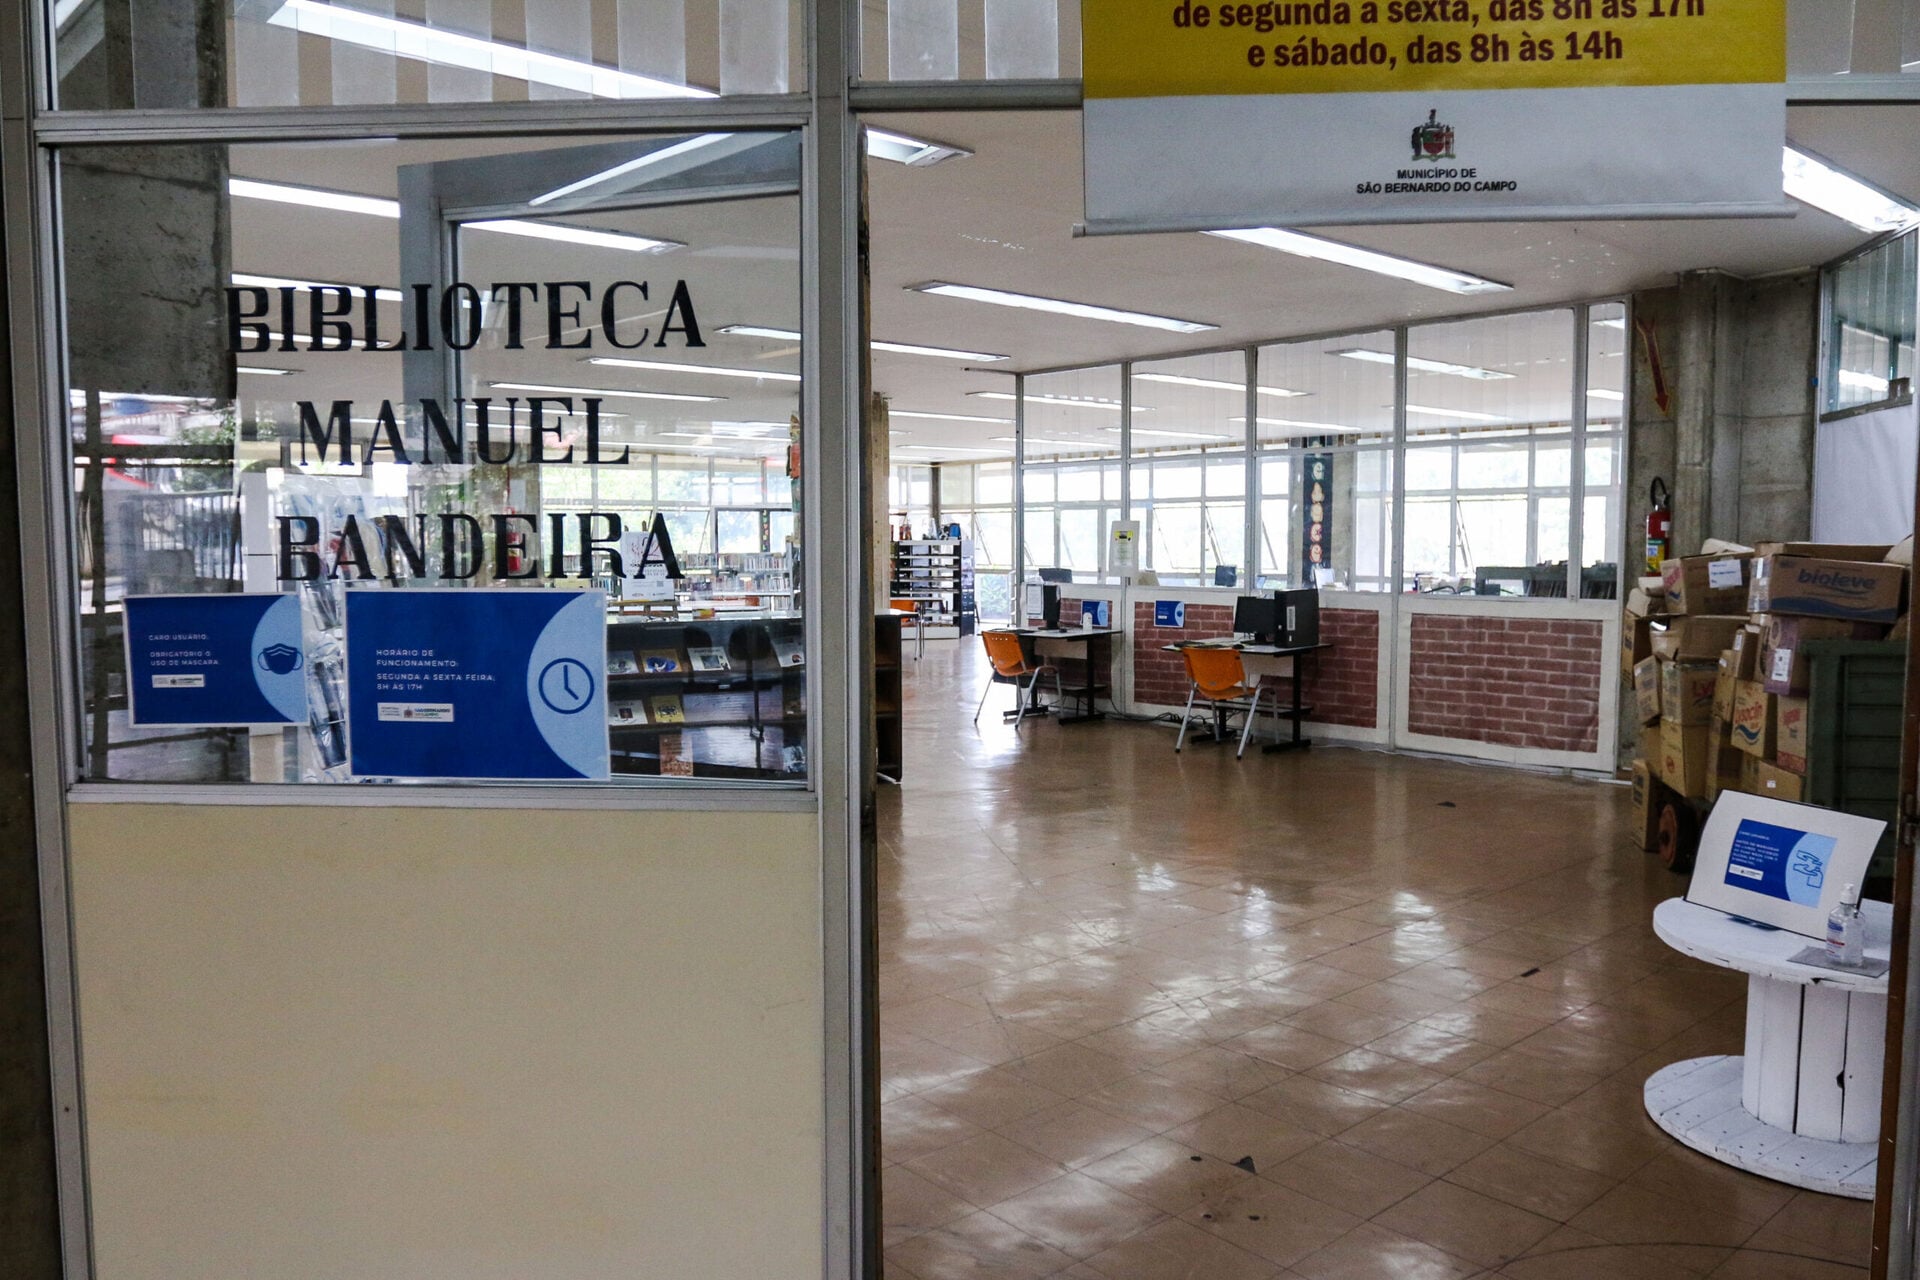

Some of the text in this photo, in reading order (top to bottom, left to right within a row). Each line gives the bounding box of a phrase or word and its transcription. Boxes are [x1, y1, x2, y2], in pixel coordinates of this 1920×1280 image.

[1173, 0, 1211, 27] de
[1219, 0, 1351, 33] segunda
[1360, 5, 1379, 24] a
[1387, 0, 1479, 27] sexta,
[1489, 0, 1545, 22] das
[1247, 30, 1624, 70] e sábado, das 8h às 14h
[1356, 180, 1518, 194] SÃO BERNARDO DO CAMPO
[1397, 167, 1477, 179] MUNICÍPIO DE
[225, 279, 706, 353] BIBLIOTECA
[296, 396, 630, 466] MANUEL
[276, 512, 685, 581] BANDEIRA
[1797, 568, 1877, 590] bioleve
[376, 649, 418, 657] HORÁRIO
